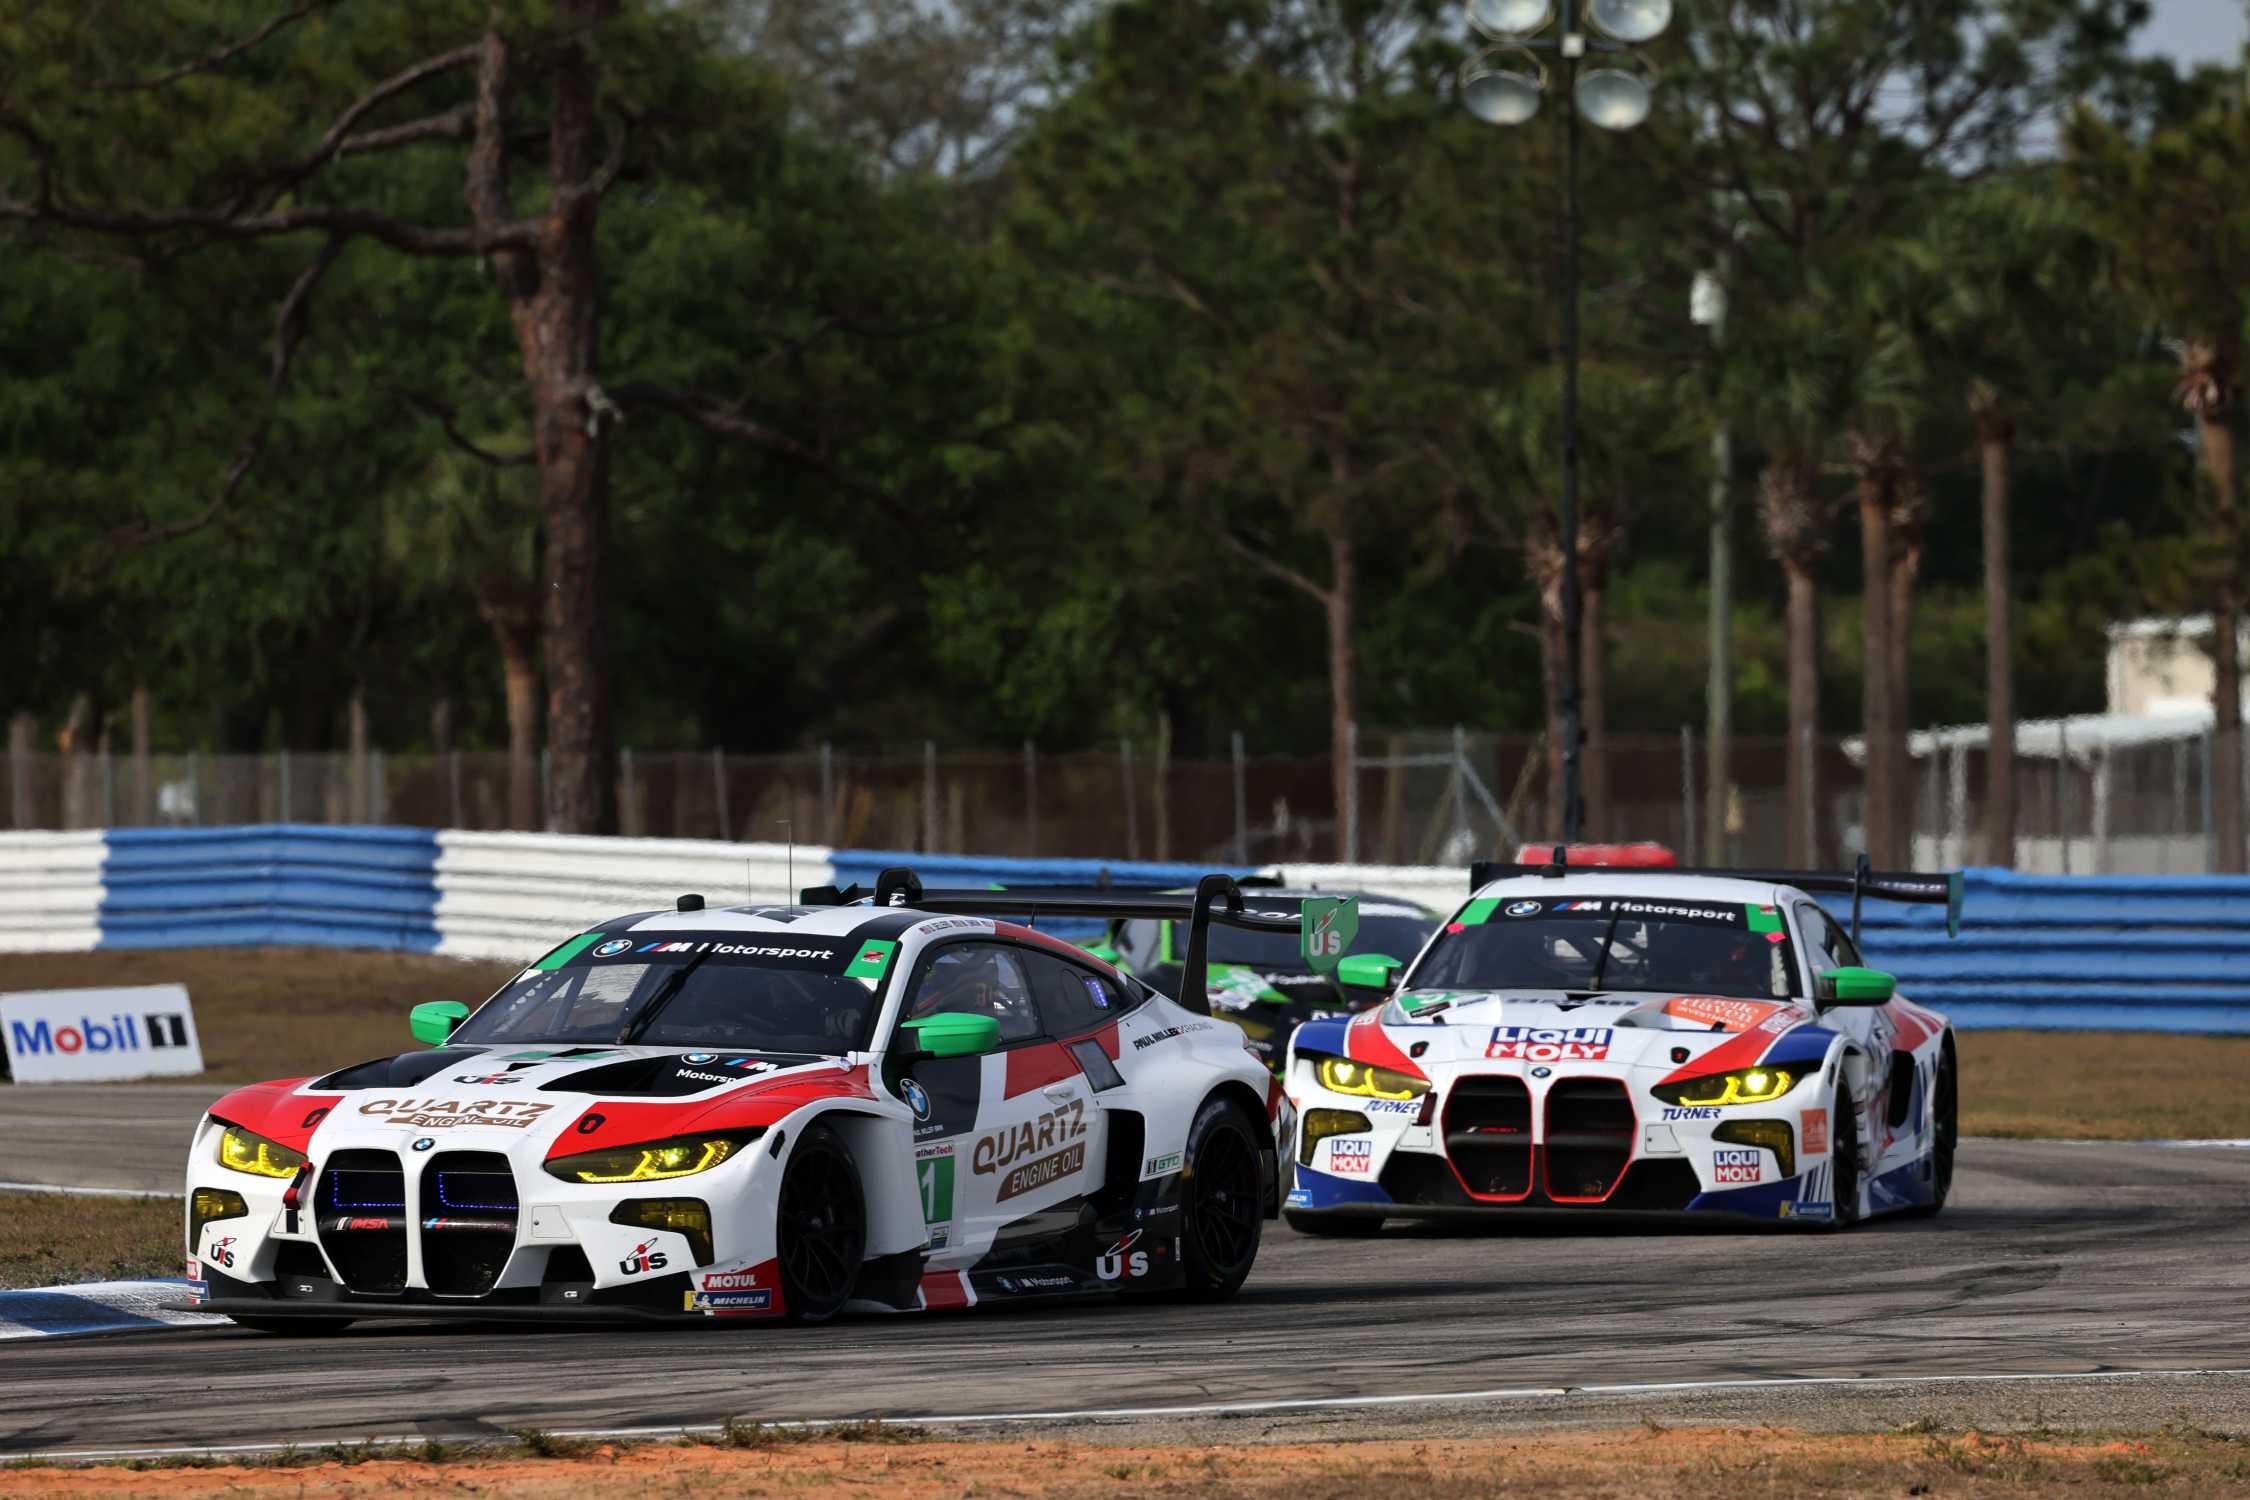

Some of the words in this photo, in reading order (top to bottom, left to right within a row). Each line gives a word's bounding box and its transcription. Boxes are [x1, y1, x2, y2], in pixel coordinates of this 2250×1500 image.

[10, 1012, 140, 1056] Mobil
[1495, 1027, 1608, 1045] LIQUI
[1490, 1043, 1608, 1061] MOLY
[676, 1068, 737, 1083] Motorsp
[358, 1098, 556, 1117] QUARTZ
[1364, 1099, 1421, 1115] TURNER
[1662, 1107, 1722, 1121] TURNER
[972, 1097, 1088, 1176] QUARTZ
[1333, 1140, 1372, 1155] LIQUI
[1332, 1156, 1370, 1172] MOLY
[1716, 1151, 1759, 1166] LIQUI
[1011, 1156, 1060, 1193] ENGINE
[1062, 1147, 1081, 1172] OIL
[1716, 1167, 1760, 1182] MOLY
[921, 1161, 936, 1221] 1
[708, 1274, 757, 1288] MOTUL
[713, 1295, 765, 1305] MICHELIN
